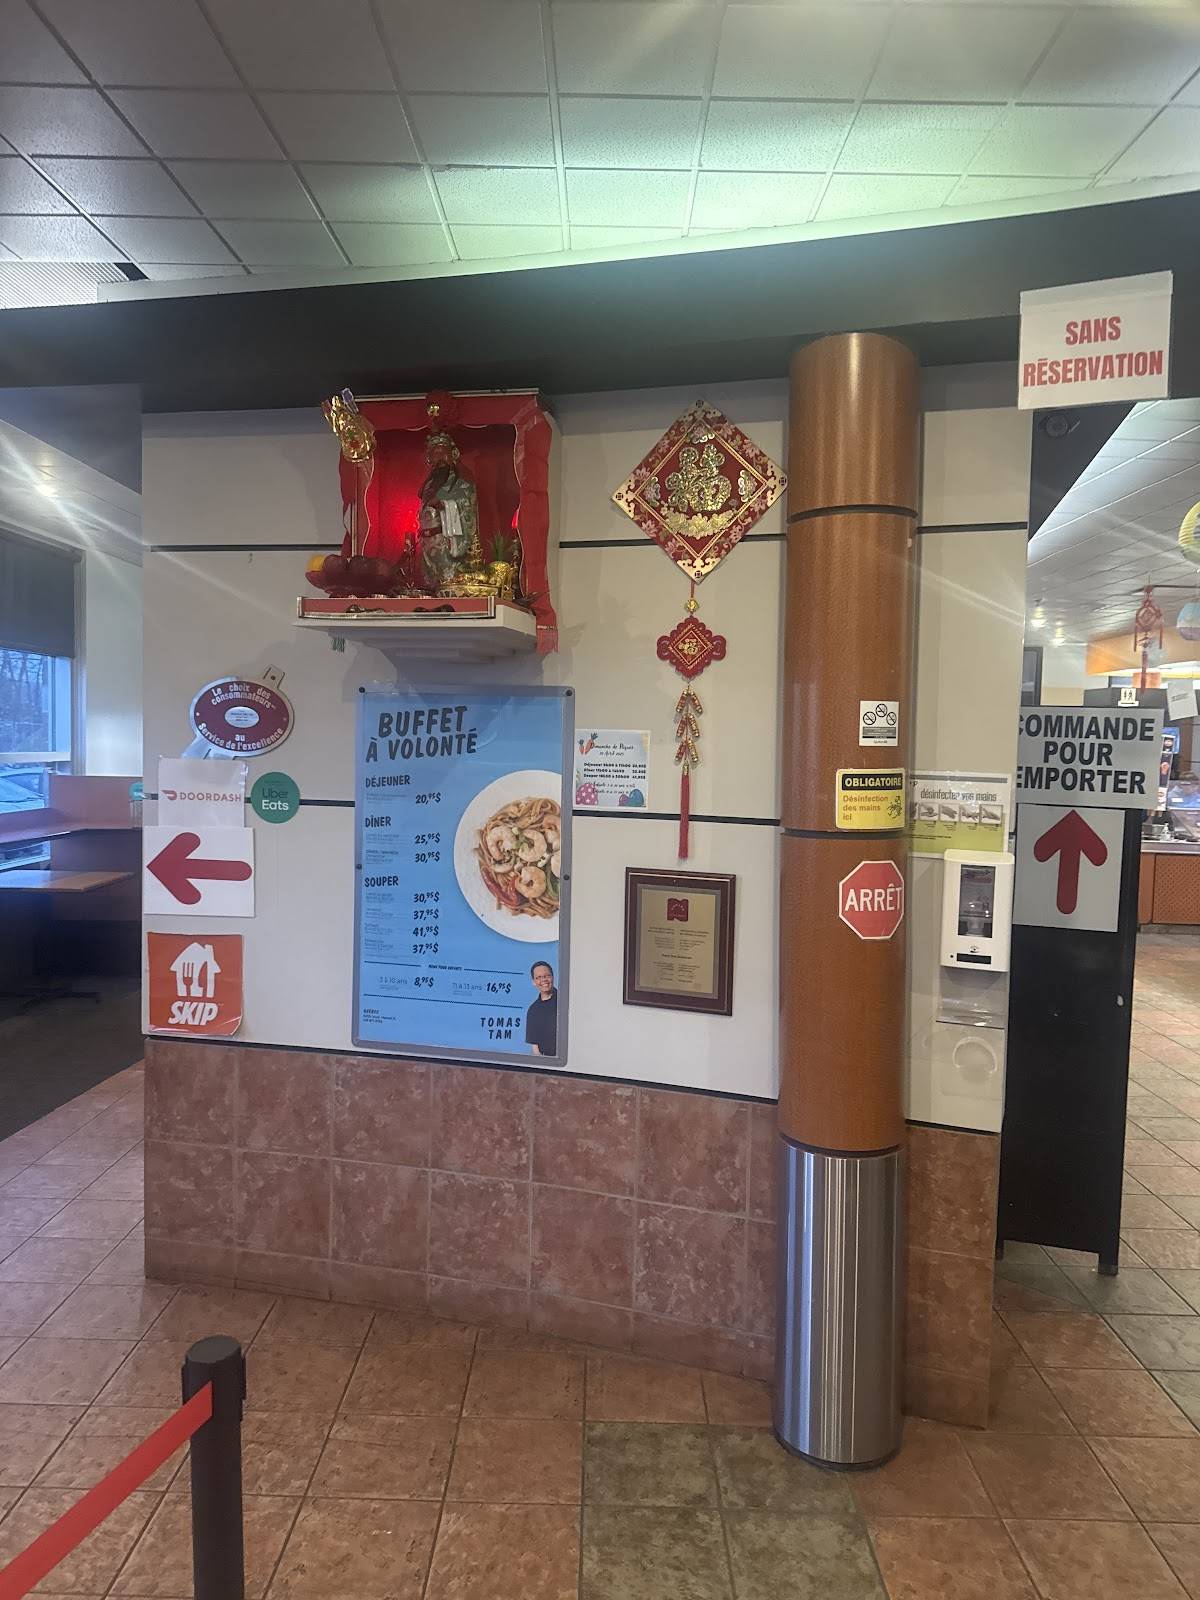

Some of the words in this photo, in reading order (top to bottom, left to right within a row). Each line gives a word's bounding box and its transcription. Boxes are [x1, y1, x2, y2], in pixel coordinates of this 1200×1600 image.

[1065, 316, 1122, 345] SANS
[1023, 350, 1164, 387] RÉSERVATION
[211, 687, 223, 697] Le
[229, 683, 251, 692] choix
[256, 687, 272, 699] des
[377, 705, 468, 738] BUFFET
[198, 722, 225, 746] Service
[225, 740, 236, 750] de
[237, 727, 284, 751] l'excellence
[234, 734, 246, 742] au
[365, 737, 378, 763] À
[388, 728, 478, 760] VOLONTÉ
[1043, 740, 1114, 766] POUR
[365, 775, 411, 788] DÉJEUNER
[844, 776, 902, 788] OBLIGATOIRE
[179, 791, 242, 802] DOORDASH
[261, 786, 289, 799] Uber
[920, 788, 960, 801] désinfectez
[961, 791, 974, 801] vos
[976, 790, 997, 802] mains
[261, 800, 289, 811] Eats
[843, 804, 857, 812] des
[859, 804, 881, 812] mains
[365, 815, 392, 828] DÎNER
[843, 812, 852, 821] ici
[414, 832, 441, 844] 25,95$
[414, 850, 441, 863] 30,95$
[364, 875, 399, 888] SOUPER
[413, 891, 440, 903] 30,95$
[844, 883, 902, 912] ARRÊT
[413, 909, 440, 921] 37,95$
[412, 926, 439, 937] 41,95$
[412, 942, 439, 954] 37,95$
[414, 976, 434, 988] 8,95$
[486, 981, 512, 994] 16,95$
[168, 1001, 219, 1026] SKIP
[480, 1017, 522, 1028] TOMAS
[488, 1029, 512, 1040] TAM
